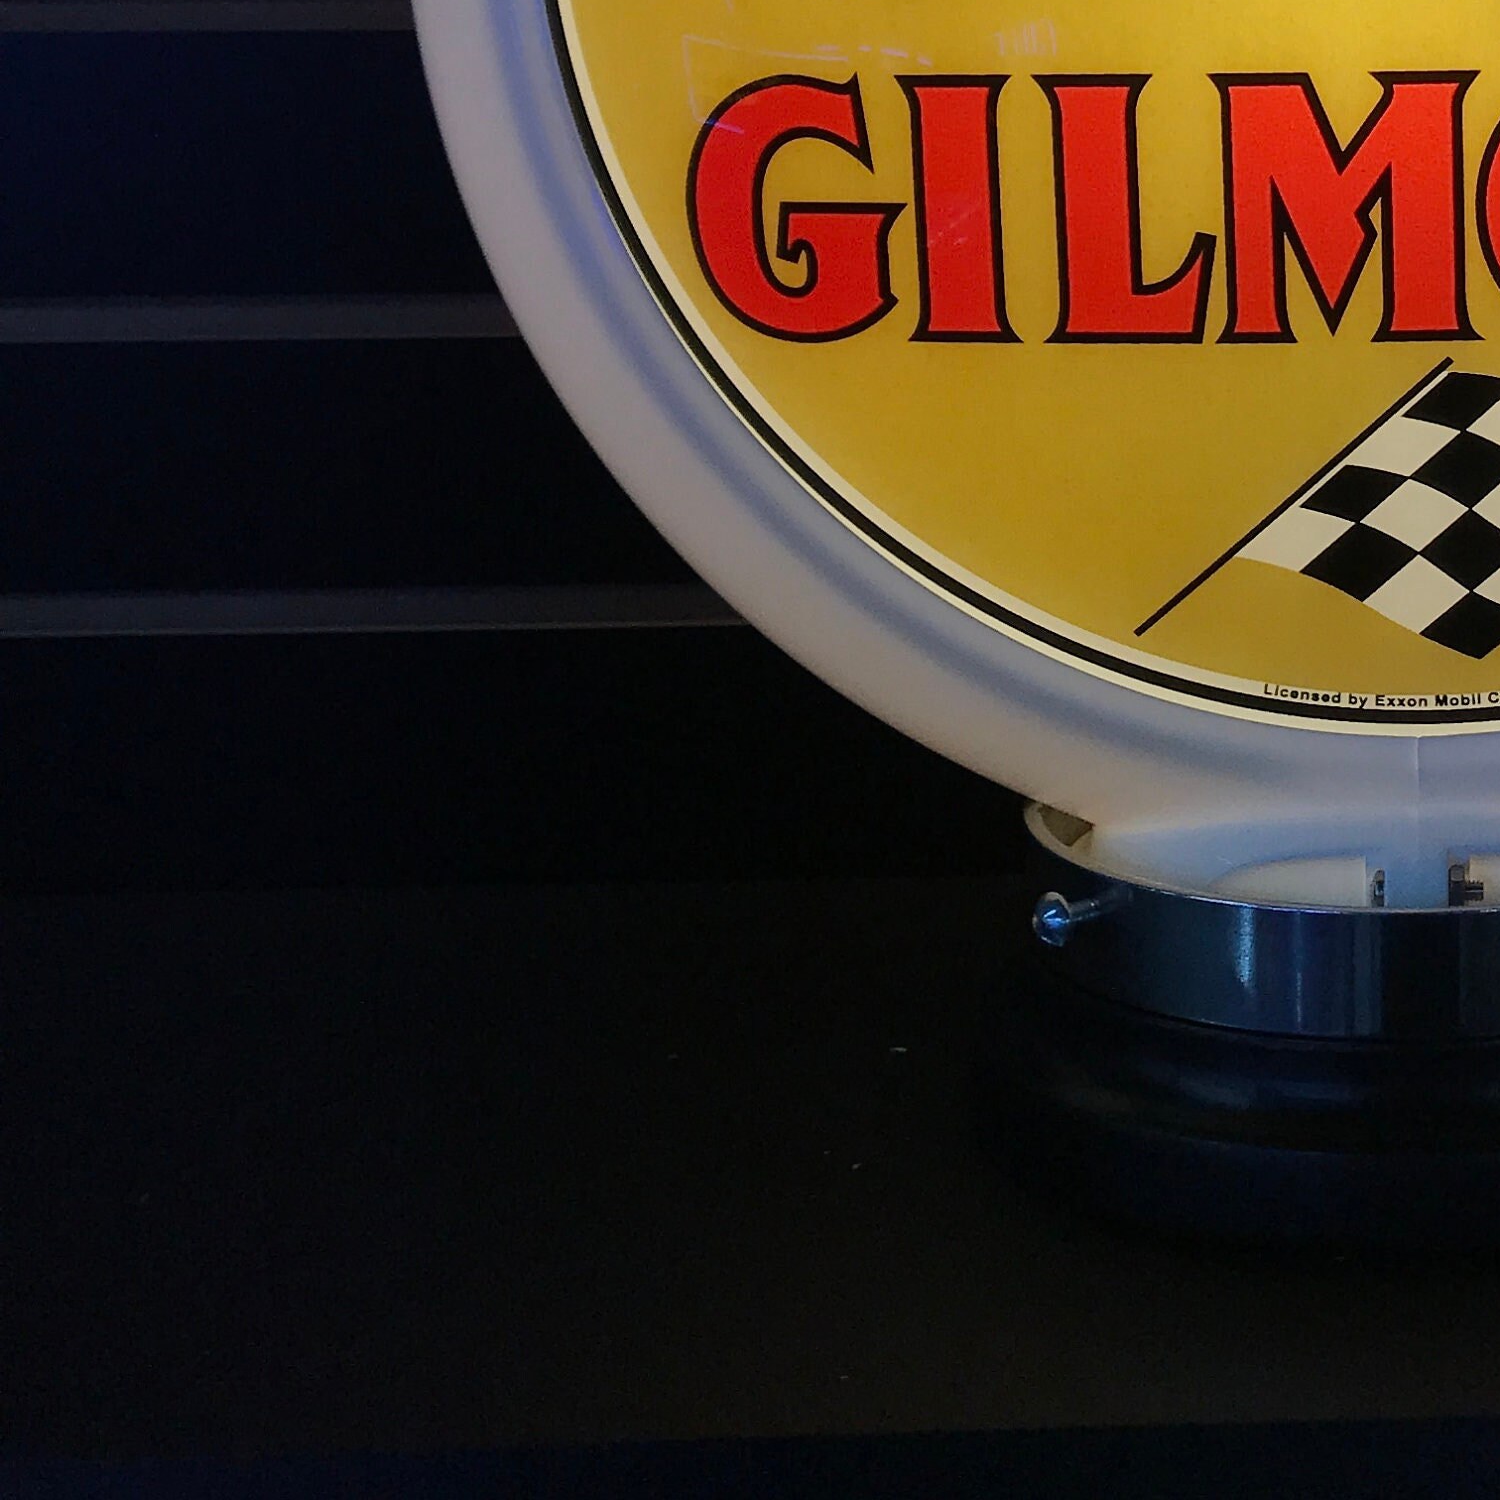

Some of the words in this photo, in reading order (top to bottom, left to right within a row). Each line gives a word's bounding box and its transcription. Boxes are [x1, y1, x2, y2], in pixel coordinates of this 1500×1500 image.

[1263, 683, 1341, 704] Licensed
[1348, 693, 1368, 709] by
[1375, 694, 1428, 707] Exxon
[1434, 693, 1482, 707] Mobil
